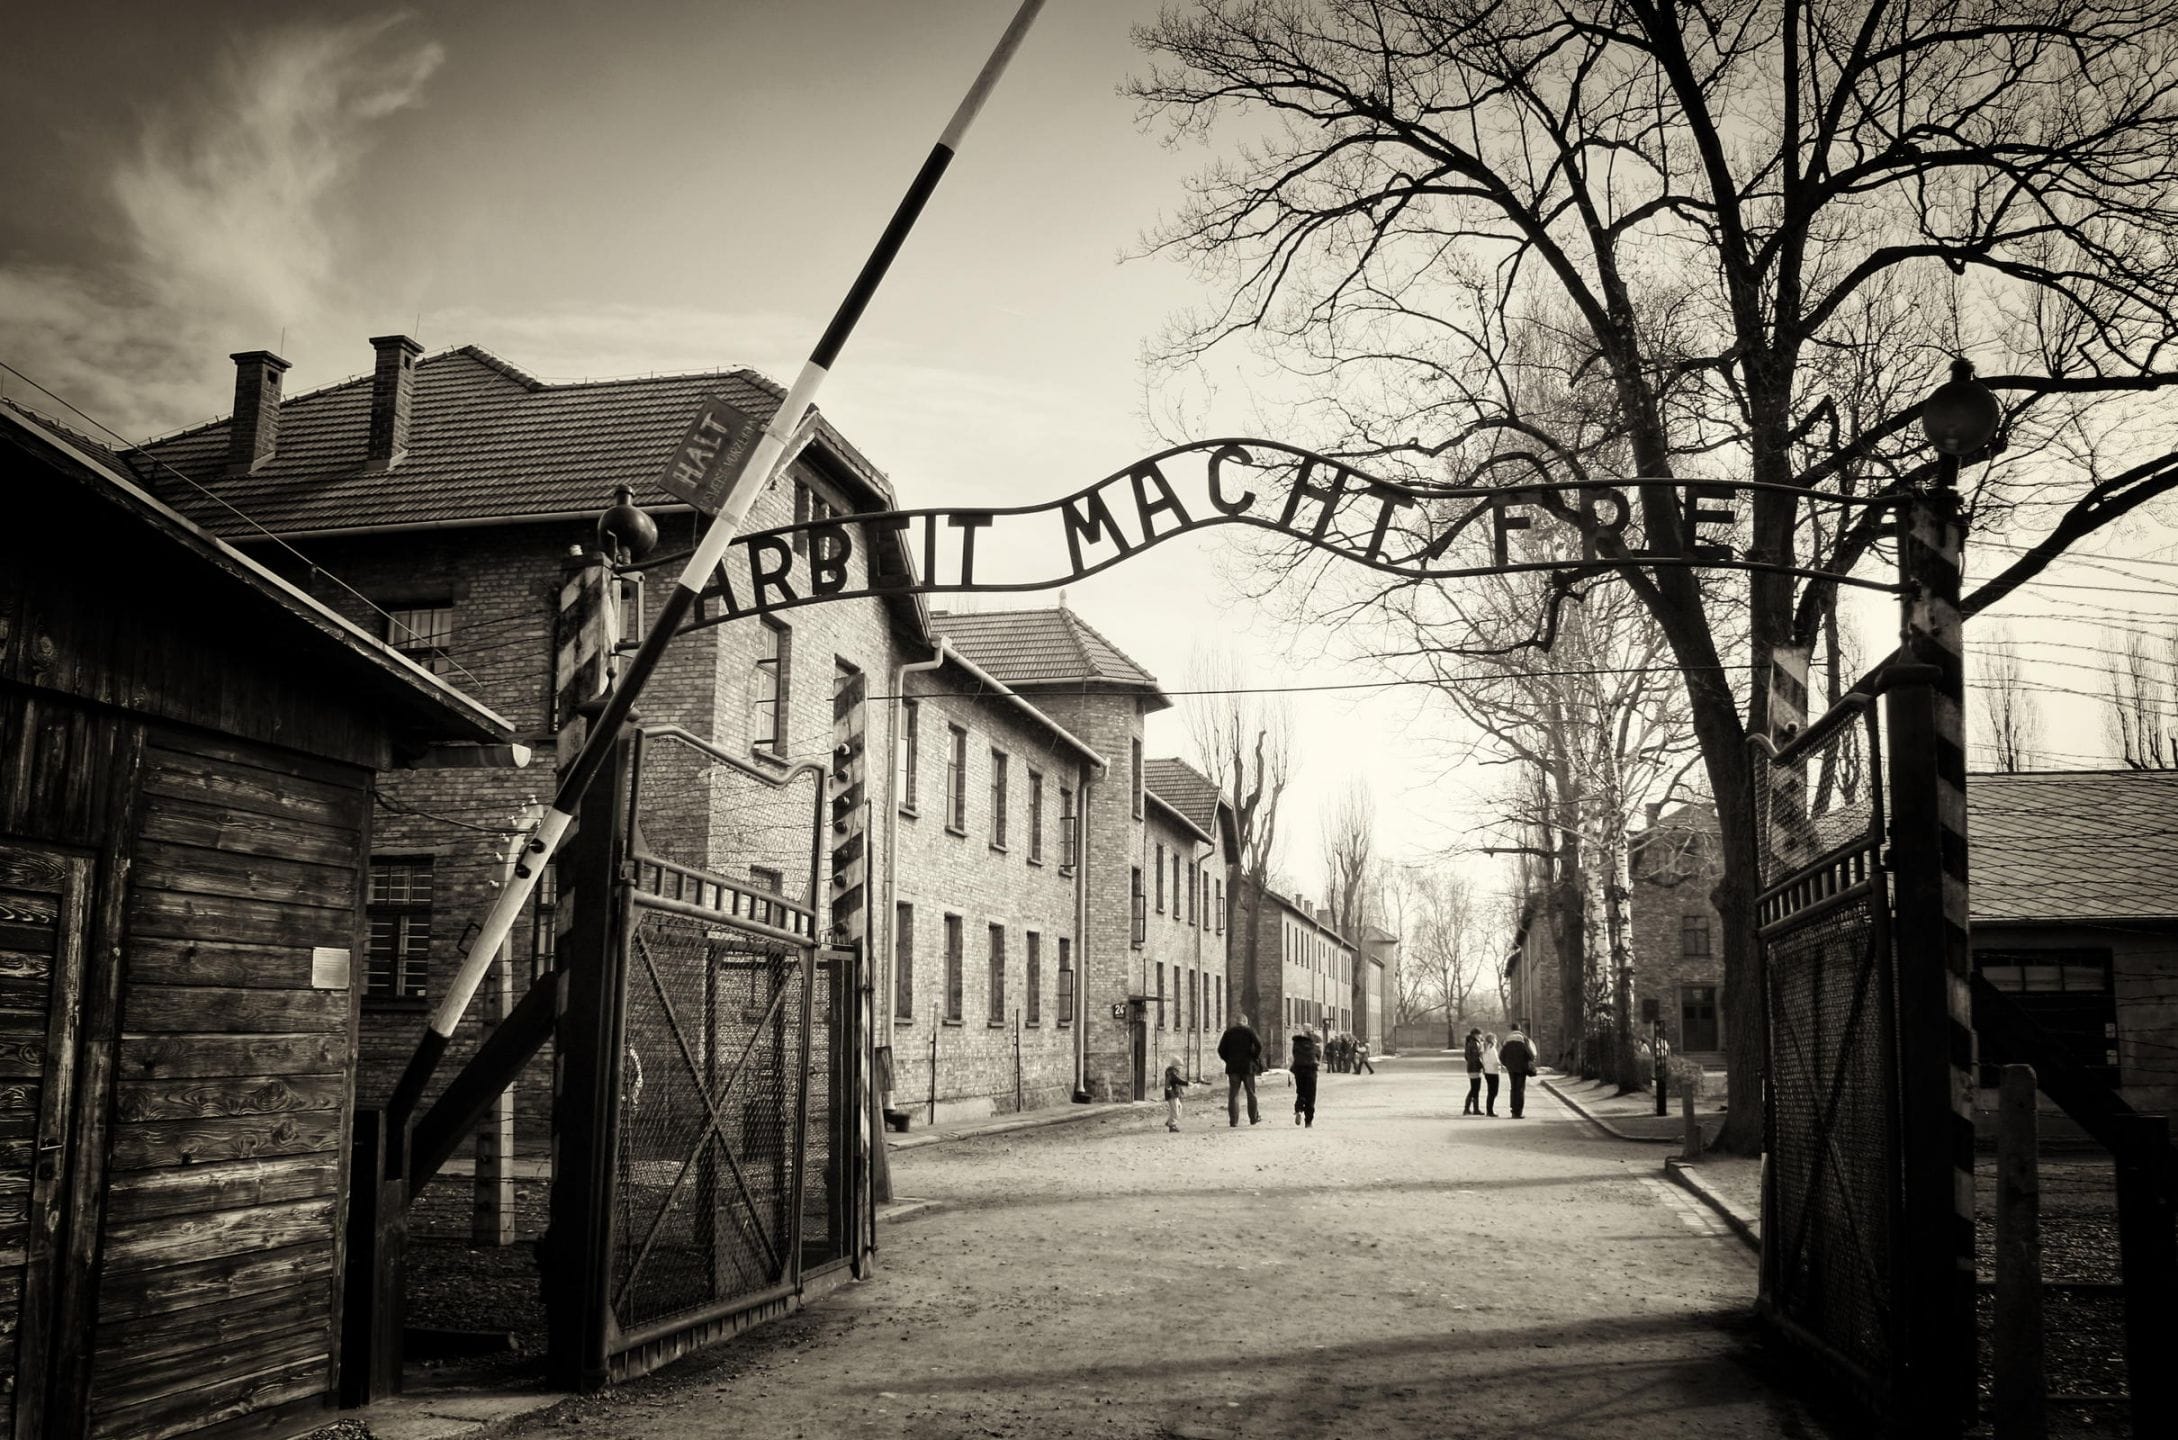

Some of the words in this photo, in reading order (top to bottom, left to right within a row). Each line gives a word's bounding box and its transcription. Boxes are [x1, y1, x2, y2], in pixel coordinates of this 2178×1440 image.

[672, 411, 728, 489] HALT
[693, 513, 994, 622] ARBEIT
[1061, 442, 1416, 577] MACHT
